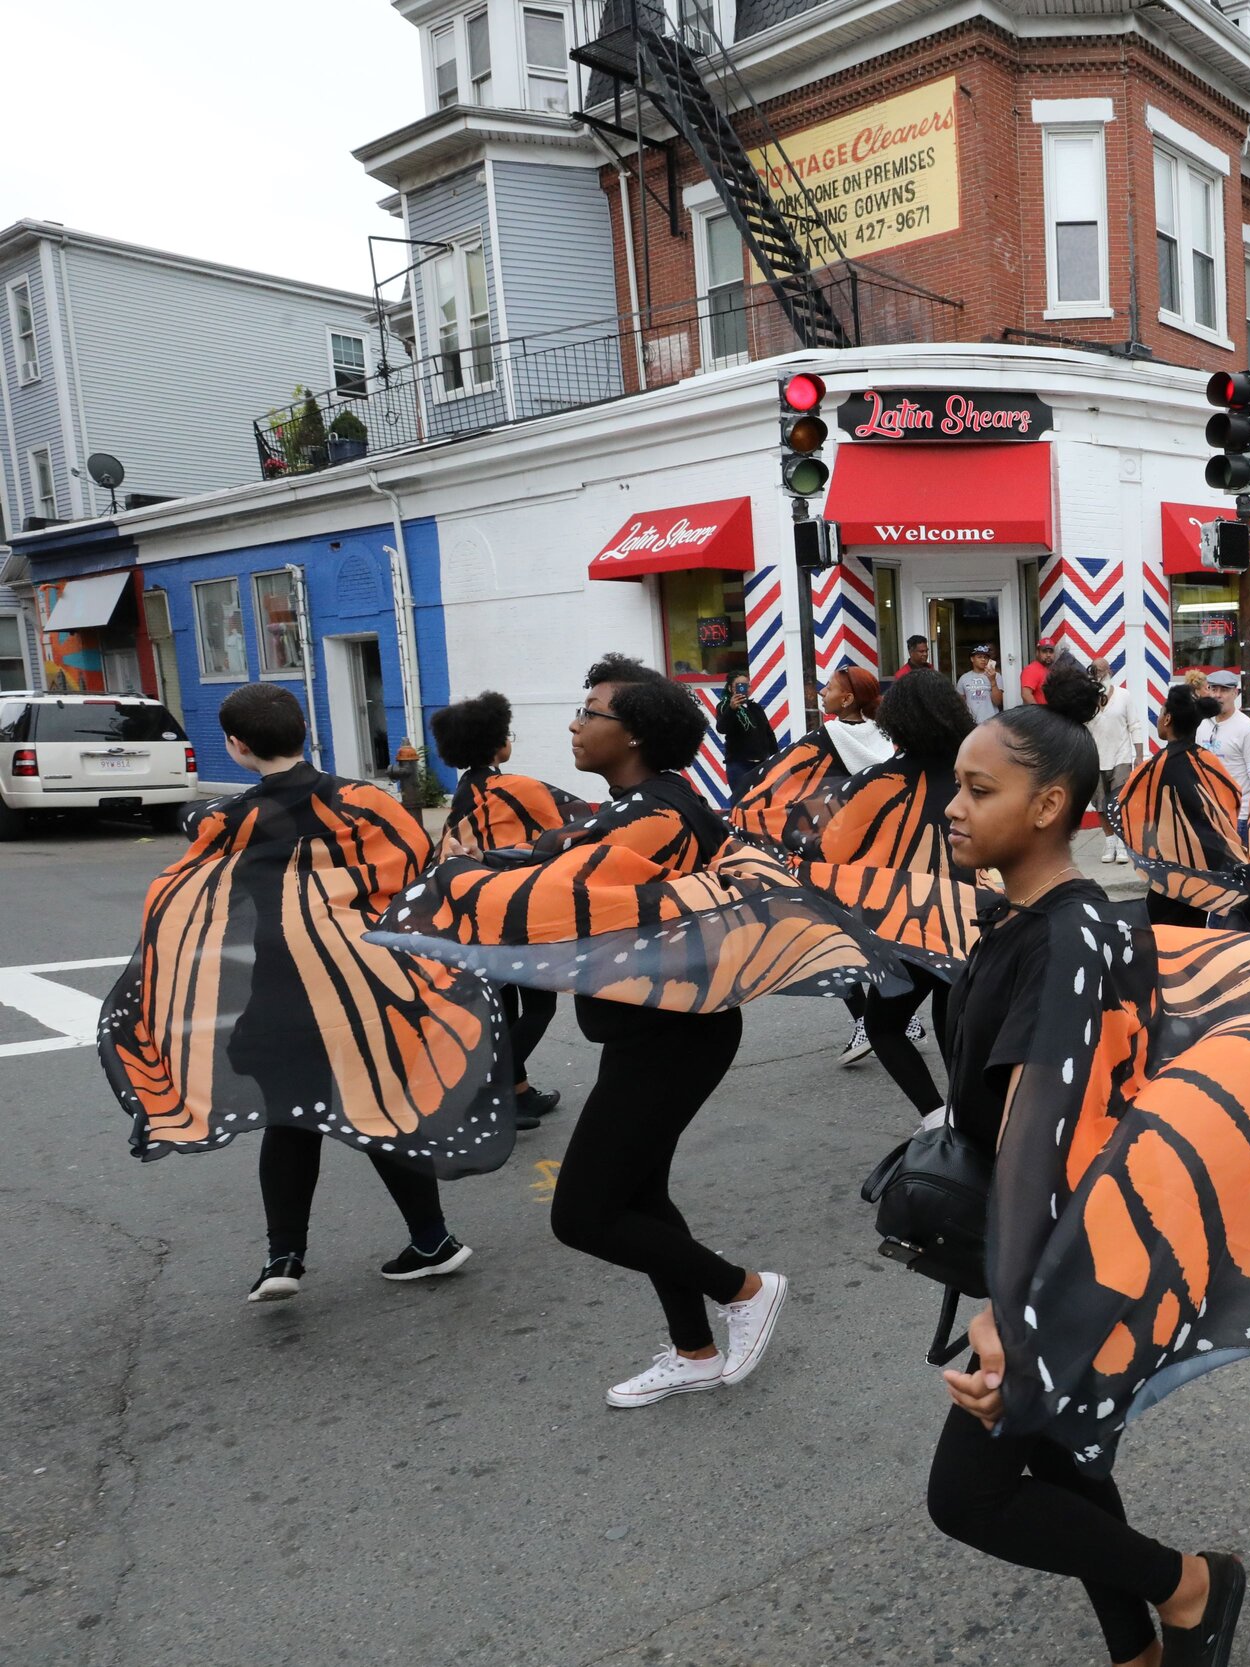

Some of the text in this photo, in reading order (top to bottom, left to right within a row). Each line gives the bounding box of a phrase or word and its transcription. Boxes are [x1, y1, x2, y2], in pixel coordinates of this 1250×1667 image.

[851, 106, 954, 163] Cleaners
[807, 179, 840, 207] DONE
[842, 172, 861, 195] ON
[865, 146, 935, 187] PREMISES
[854, 180, 916, 218] GOWNS
[856, 204, 930, 243] 427-9671
[855, 391, 1032, 438] Latin Shears
[599, 518, 718, 561] Latin Shears
[873, 525, 995, 541] Welcome
[1201, 618, 1233, 636] OPEN
